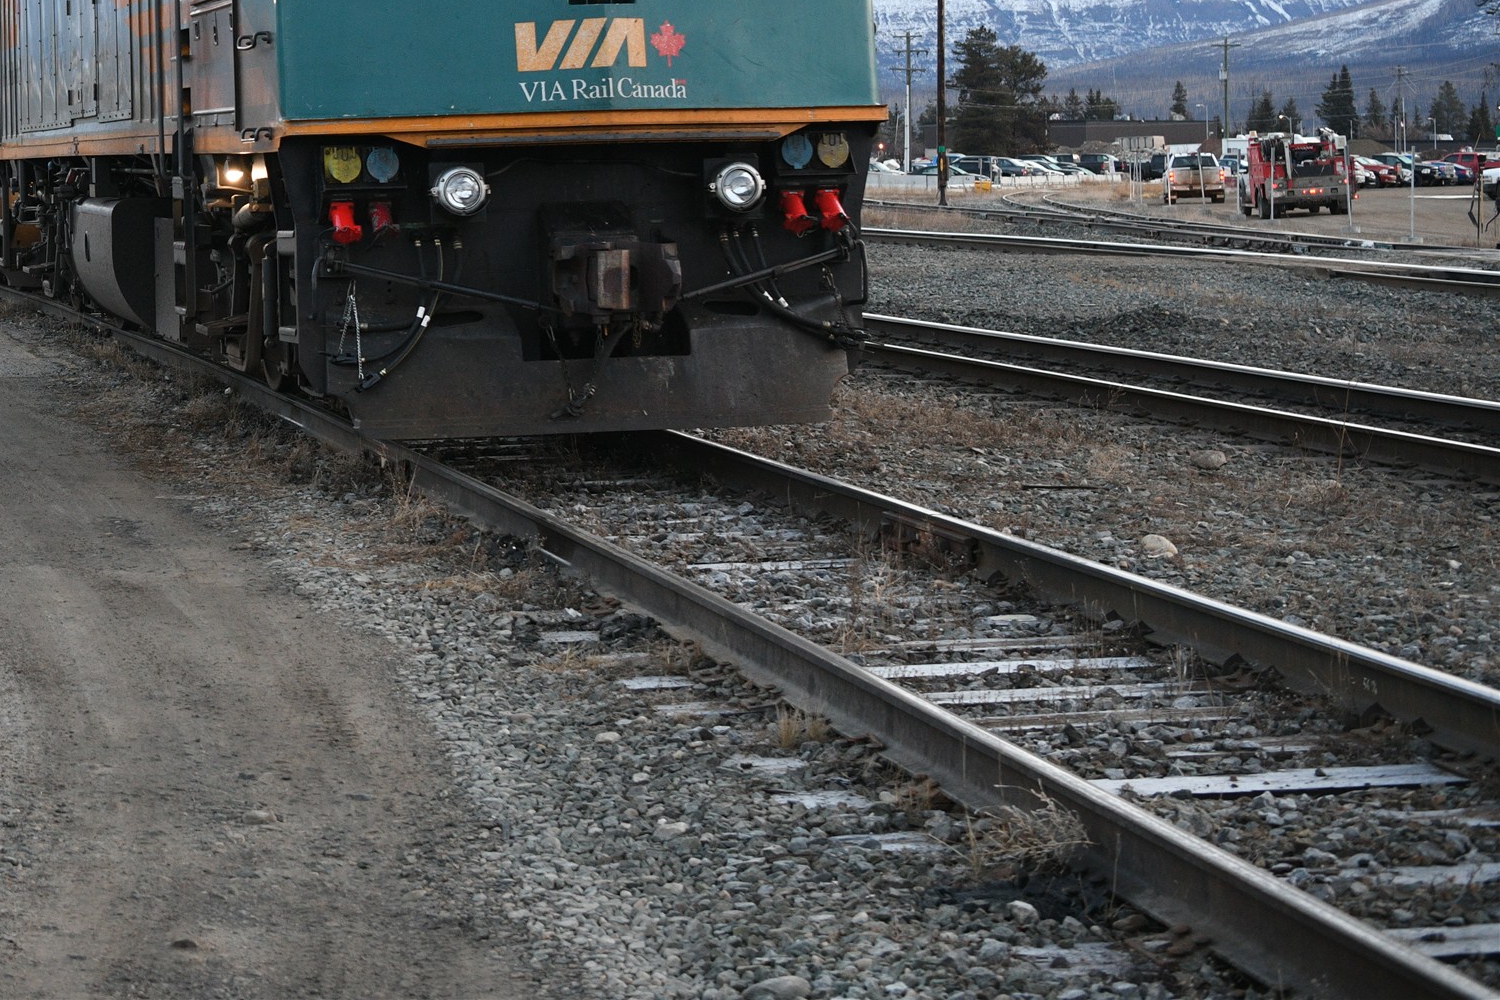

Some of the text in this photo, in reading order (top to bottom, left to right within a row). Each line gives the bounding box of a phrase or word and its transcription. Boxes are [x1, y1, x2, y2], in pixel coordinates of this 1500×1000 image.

[514, 17, 647, 72] VIA
[519, 77, 687, 102] VIA Rail Canada
